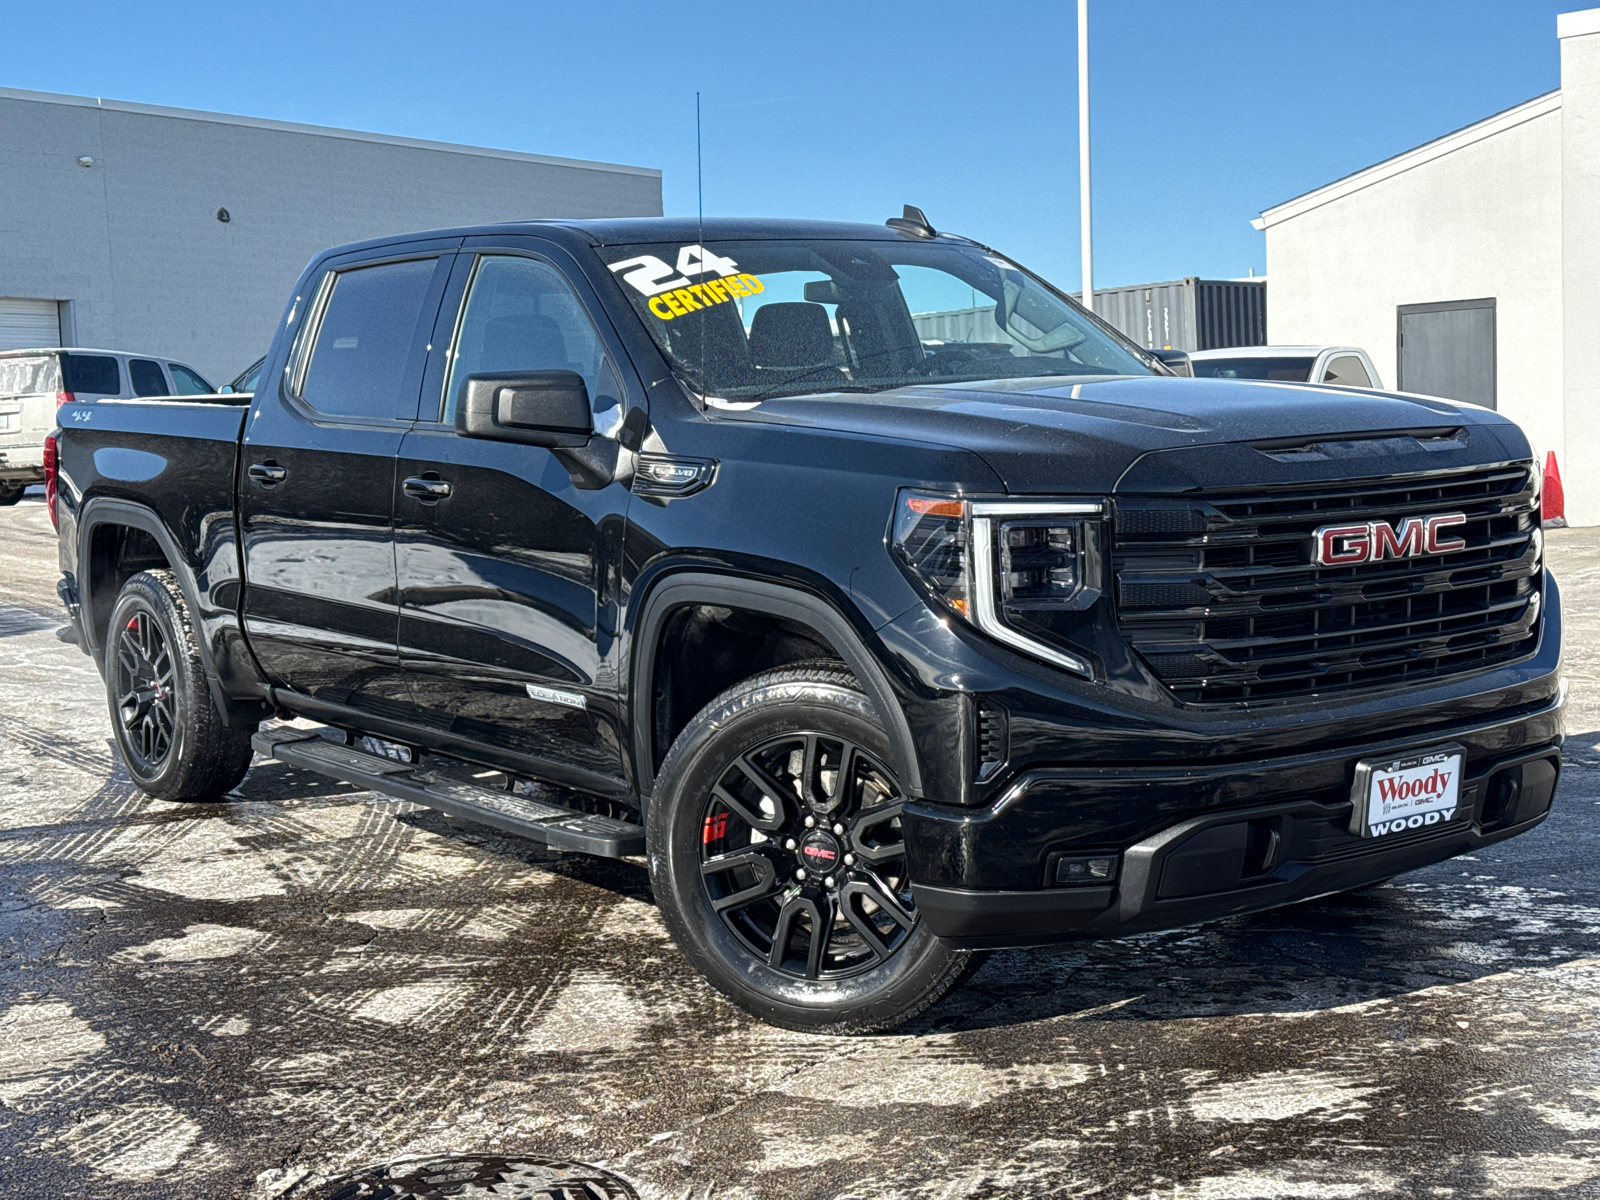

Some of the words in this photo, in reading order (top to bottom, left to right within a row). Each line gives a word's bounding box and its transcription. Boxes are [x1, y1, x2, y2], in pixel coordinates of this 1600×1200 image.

[607, 244, 741, 297] 24
[648, 273, 765, 320] CERTIFIED
[1311, 511, 1467, 566] GMC
[531, 689, 585, 706] ELEVATION
[1422, 754, 1446, 764] GMC
[1377, 768, 1452, 804] Woody
[1414, 796, 1434, 806] GMC
[1370, 808, 1456, 838] WOODY
[804, 845, 836, 860] GMC
